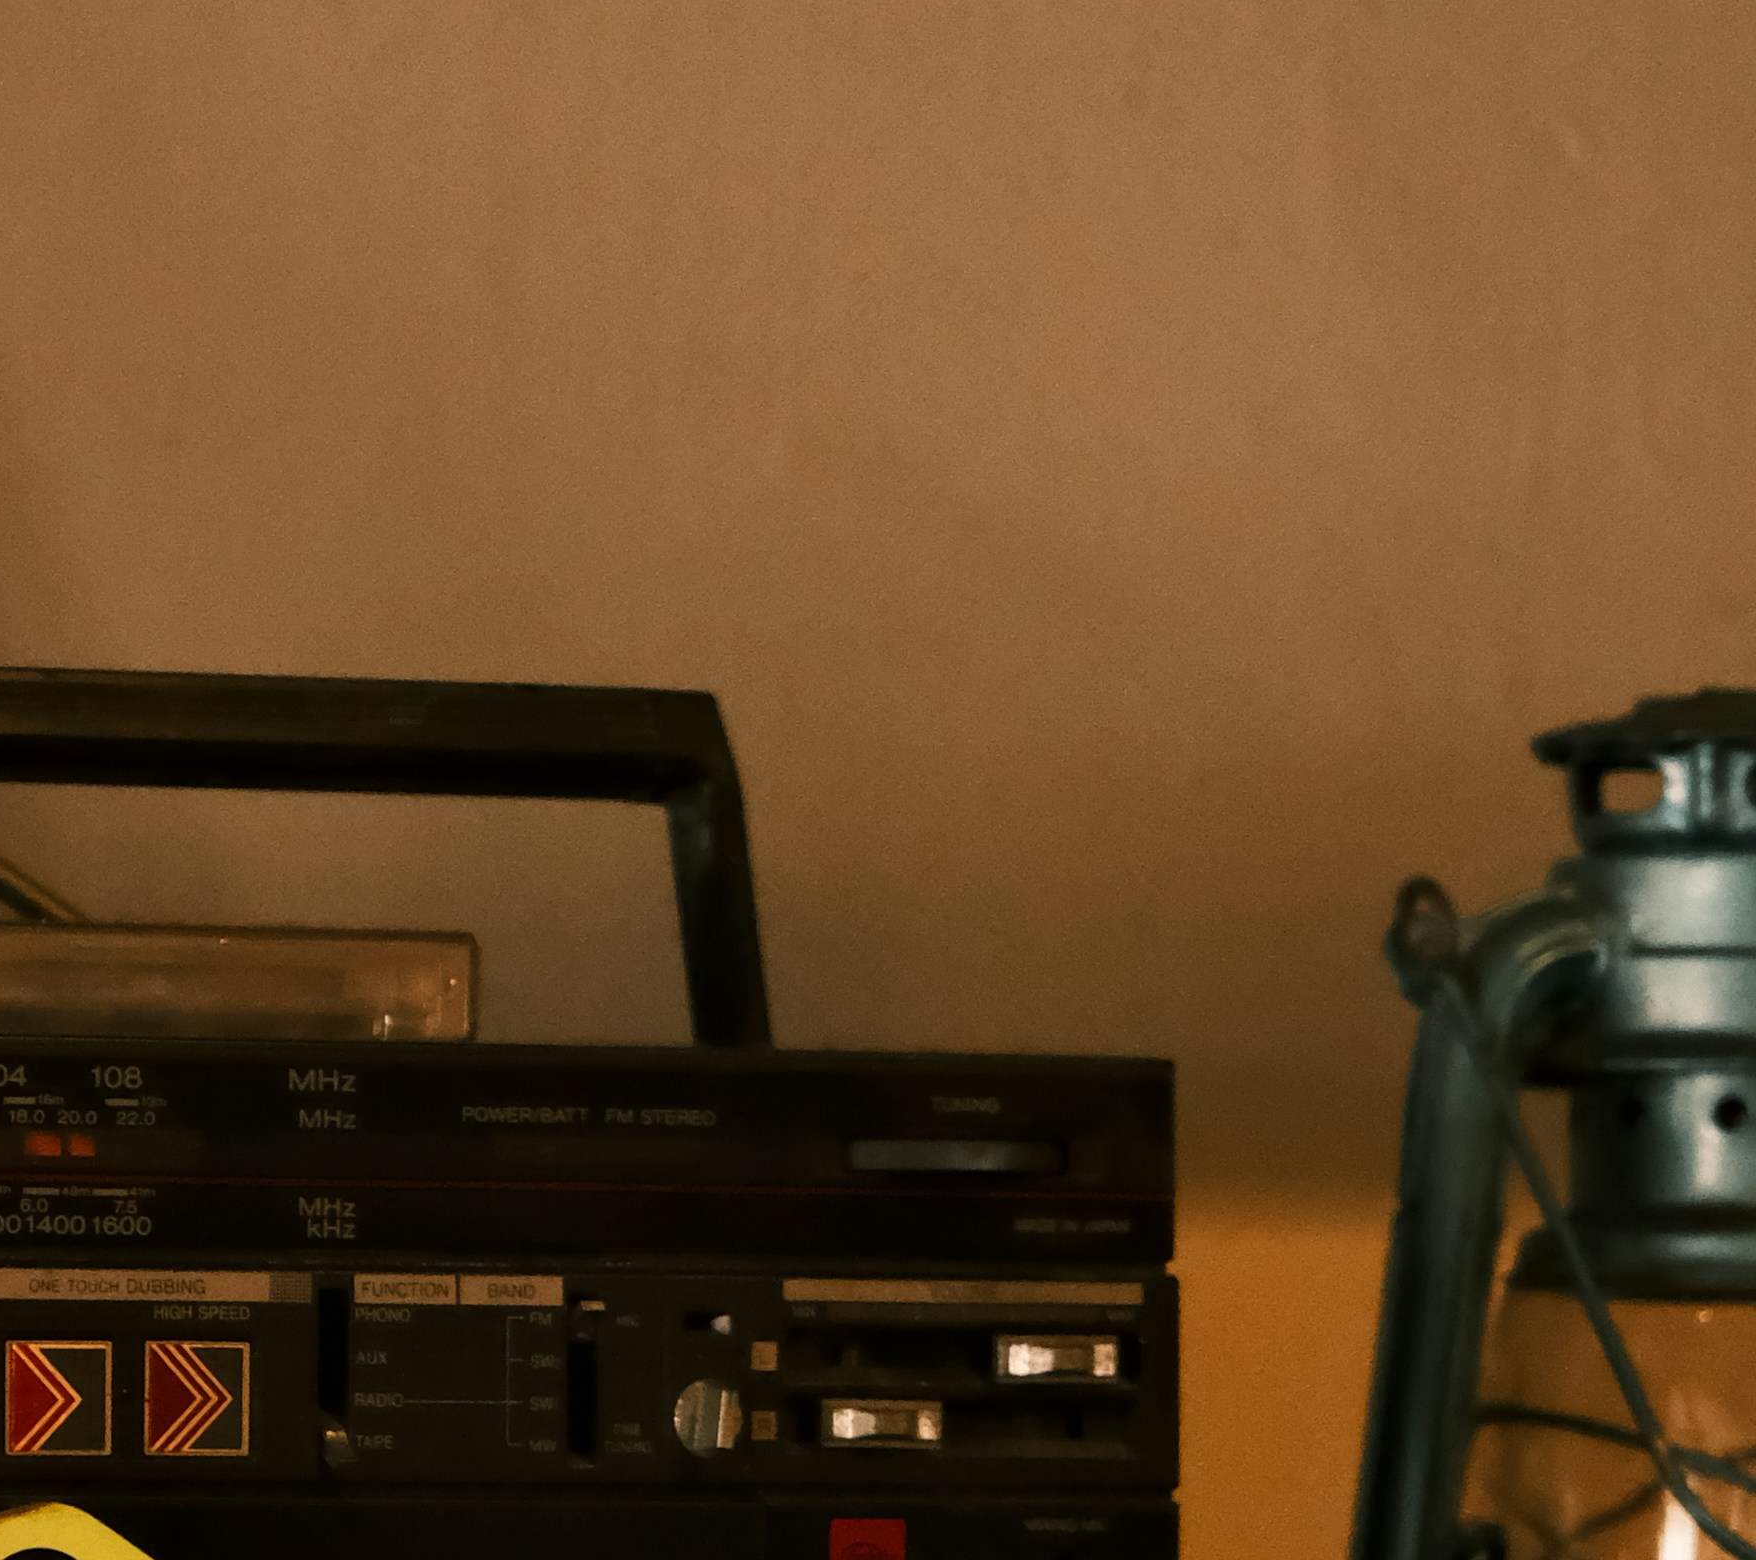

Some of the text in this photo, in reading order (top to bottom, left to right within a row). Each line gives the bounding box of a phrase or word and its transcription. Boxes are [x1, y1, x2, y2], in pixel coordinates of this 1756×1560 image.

[91, 1065, 144, 1089] 108
[288, 1068, 357, 1093] MHz
[8, 1108, 46, 1125] 18.0
[56, 1109, 98, 1126] 20.0
[115, 1109, 156, 1127] 22.0
[298, 1108, 357, 1130] MHz
[461, 1105, 589, 1125] POWER/BATT
[640, 1108, 718, 1127] STEREO
[19, 1197, 49, 1213] 6.0
[114, 1199, 138, 1214] 7.5
[298, 1196, 357, 1218] MHz
[26, 1214, 86, 1235] 1400
[92, 1215, 152, 1237] 1600
[306, 1218, 356, 1239] kHz
[28, 1278, 206, 1295] ONE TOUCH DUBBING
[361, 1282, 449, 1298] FUNCTION
[487, 1283, 535, 1298] BAND
[153, 1305, 251, 1322] HIGH SPEED
[355, 1307, 412, 1323] PHONO
[355, 1350, 388, 1366] AUX
[354, 1392, 404, 1408] RADIO
[356, 1434, 394, 1450] TAPE
